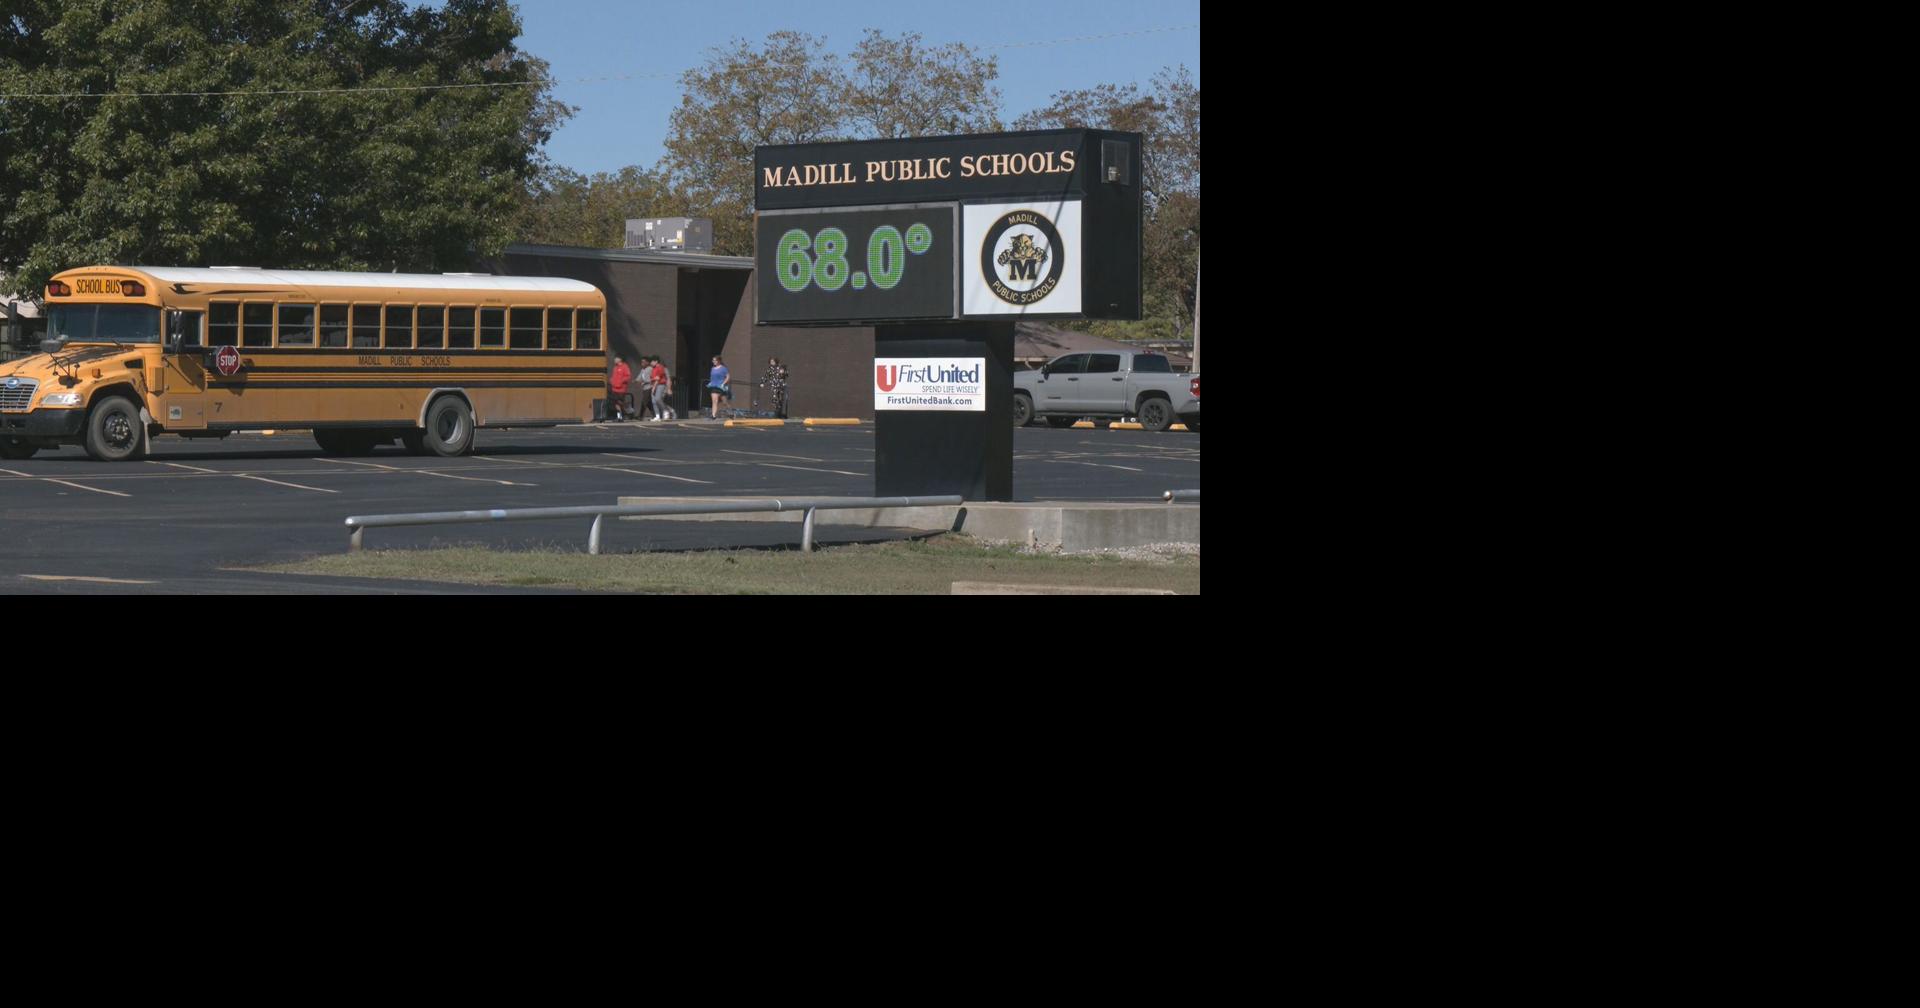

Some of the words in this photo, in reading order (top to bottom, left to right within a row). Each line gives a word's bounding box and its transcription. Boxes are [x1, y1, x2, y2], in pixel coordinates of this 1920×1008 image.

[763, 163, 857, 188] MADILL
[865, 157, 951, 183] PUBLIC
[960, 150, 1076, 177] SCHOOLS
[1008, 214, 1038, 225] MADILL
[776, 223, 933, 292] 68.0°
[1009, 259, 1037, 281] M
[76, 279, 104, 294] SCHOOL
[105, 280, 122, 294] BUS
[992, 280, 1019, 301] PUBLIC
[1021, 277, 1056, 303] SCHOOLS
[220, 355, 237, 366] STOP
[358, 355, 381, 366] MADILL
[390, 355, 412, 366] PUBLIC
[421, 356, 451, 367] SCHOOLS
[922, 385, 942, 393] SPEND
[943, 385, 954, 393] LIFE
[956, 385, 978, 393] WISELY
[887, 396, 972, 405] FirstUnitedBank.com
[215, 402, 223, 412] 7
